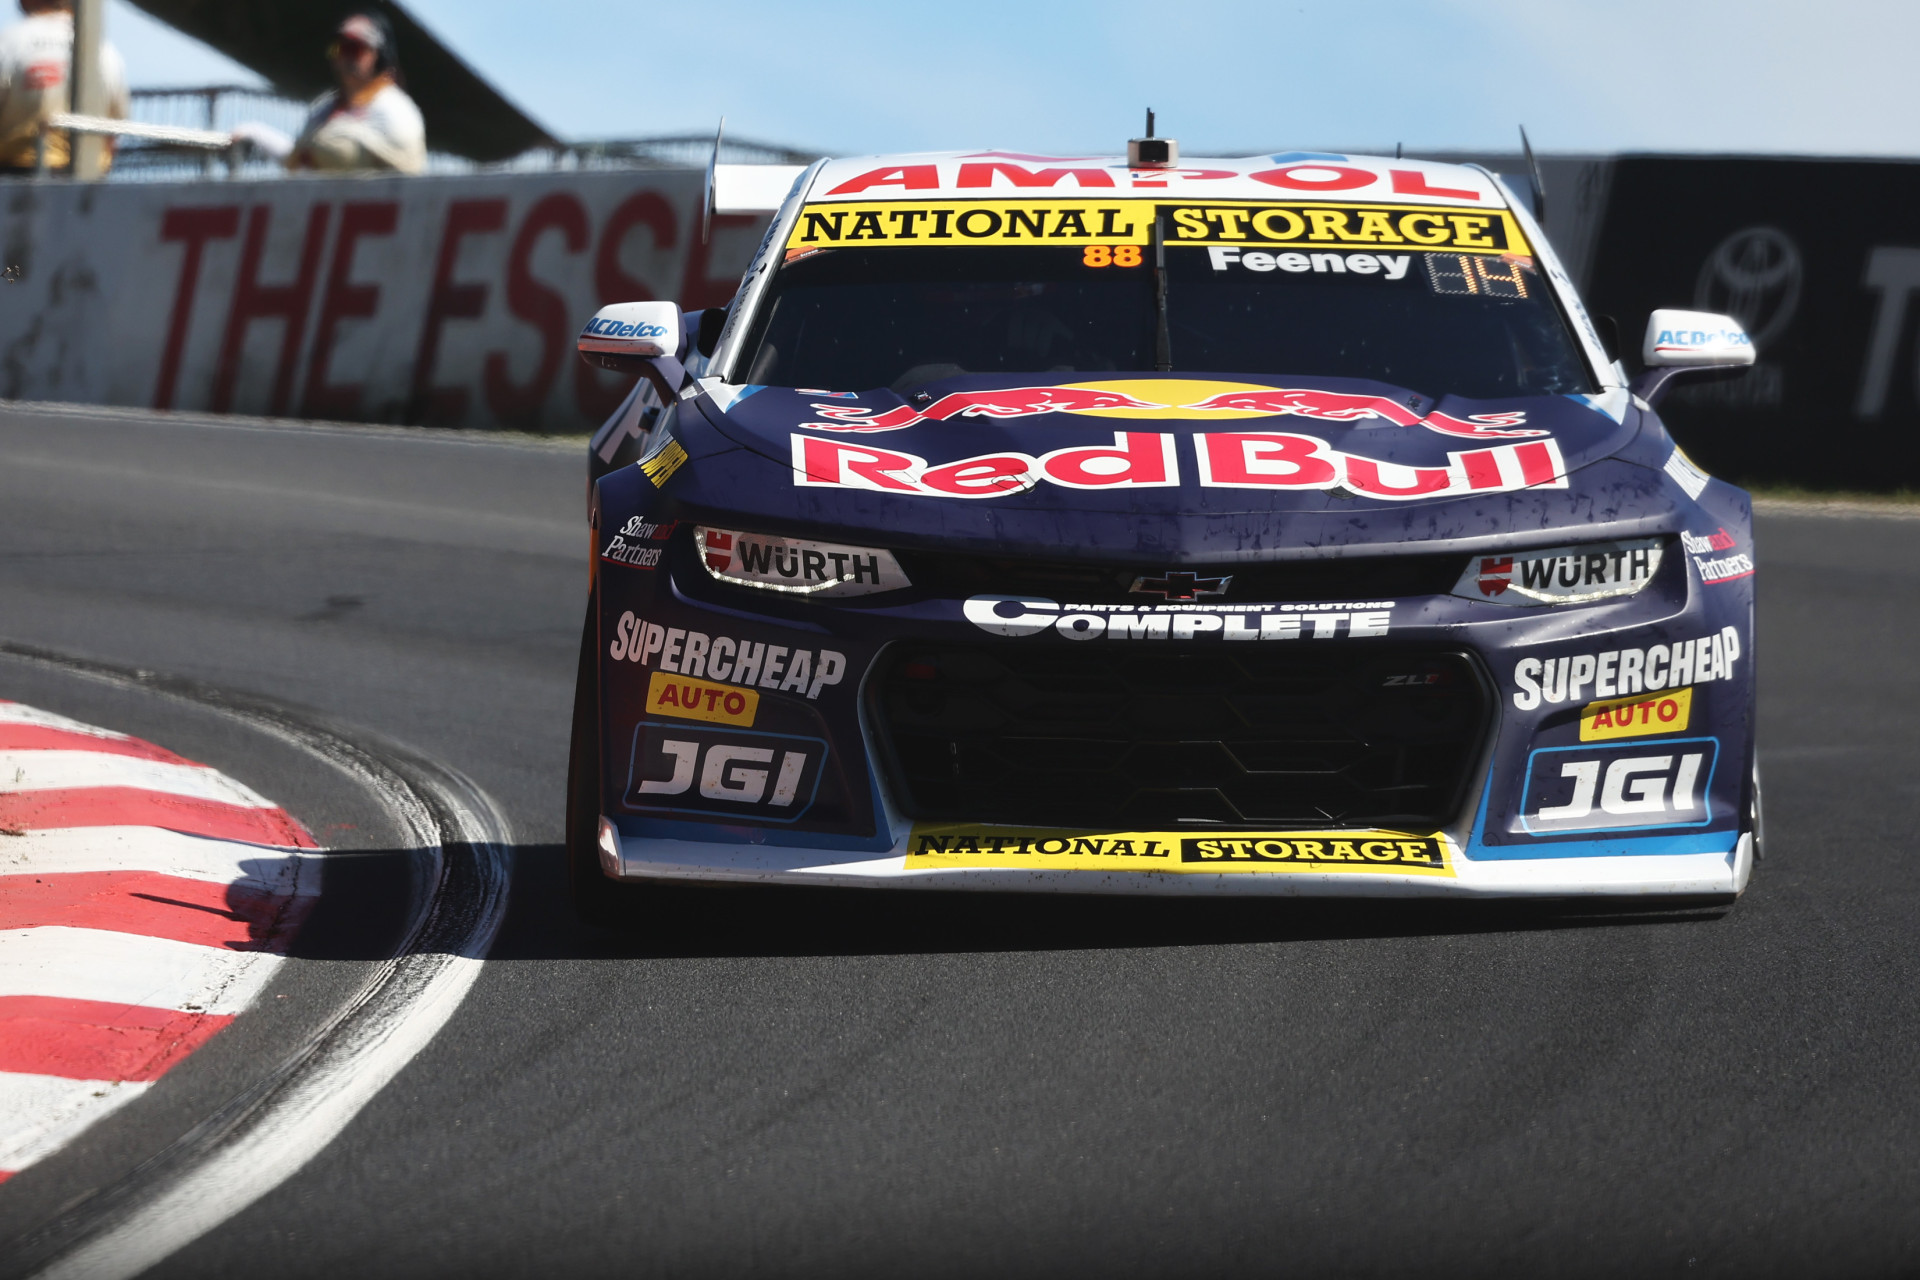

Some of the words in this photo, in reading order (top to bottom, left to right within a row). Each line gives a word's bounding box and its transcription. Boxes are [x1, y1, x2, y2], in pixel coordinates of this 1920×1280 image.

[823, 162, 1480, 201] AMPOL
[799, 207, 1137, 243] NATIONAL
[1172, 207, 1494, 248] STORAGE
[1082, 245, 1143, 268] 88
[1206, 246, 1411, 280] Feeney
[153, 198, 398, 415] THE
[582, 317, 668, 338] ACDelco
[790, 430, 1182, 500] Red
[1192, 432, 1570, 502] Bull
[619, 515, 659, 540] Shaw
[601, 535, 663, 567] Partners
[738, 540, 881, 586] WÜRTH
[1521, 546, 1650, 590] WÜRTH
[1693, 553, 1754, 582] Partners
[962, 593, 1391, 642] COMPLETE
[1063, 603, 1136, 613] PARTS
[1137, 603, 1152, 613] &
[1154, 603, 1276, 613] EQUIPMENT
[1279, 600, 1396, 612] SOLUTIONS
[609, 610, 848, 701] SUPERCHEAP
[1512, 625, 1741, 712] SUPERCHEAP
[656, 682, 747, 717] AUTO
[1591, 698, 1680, 731] AUTO
[637, 739, 808, 808] JGI
[1537, 752, 1704, 822] JGI
[913, 834, 1171, 859] NATIONAL
[1198, 838, 1432, 864] STORAGE
